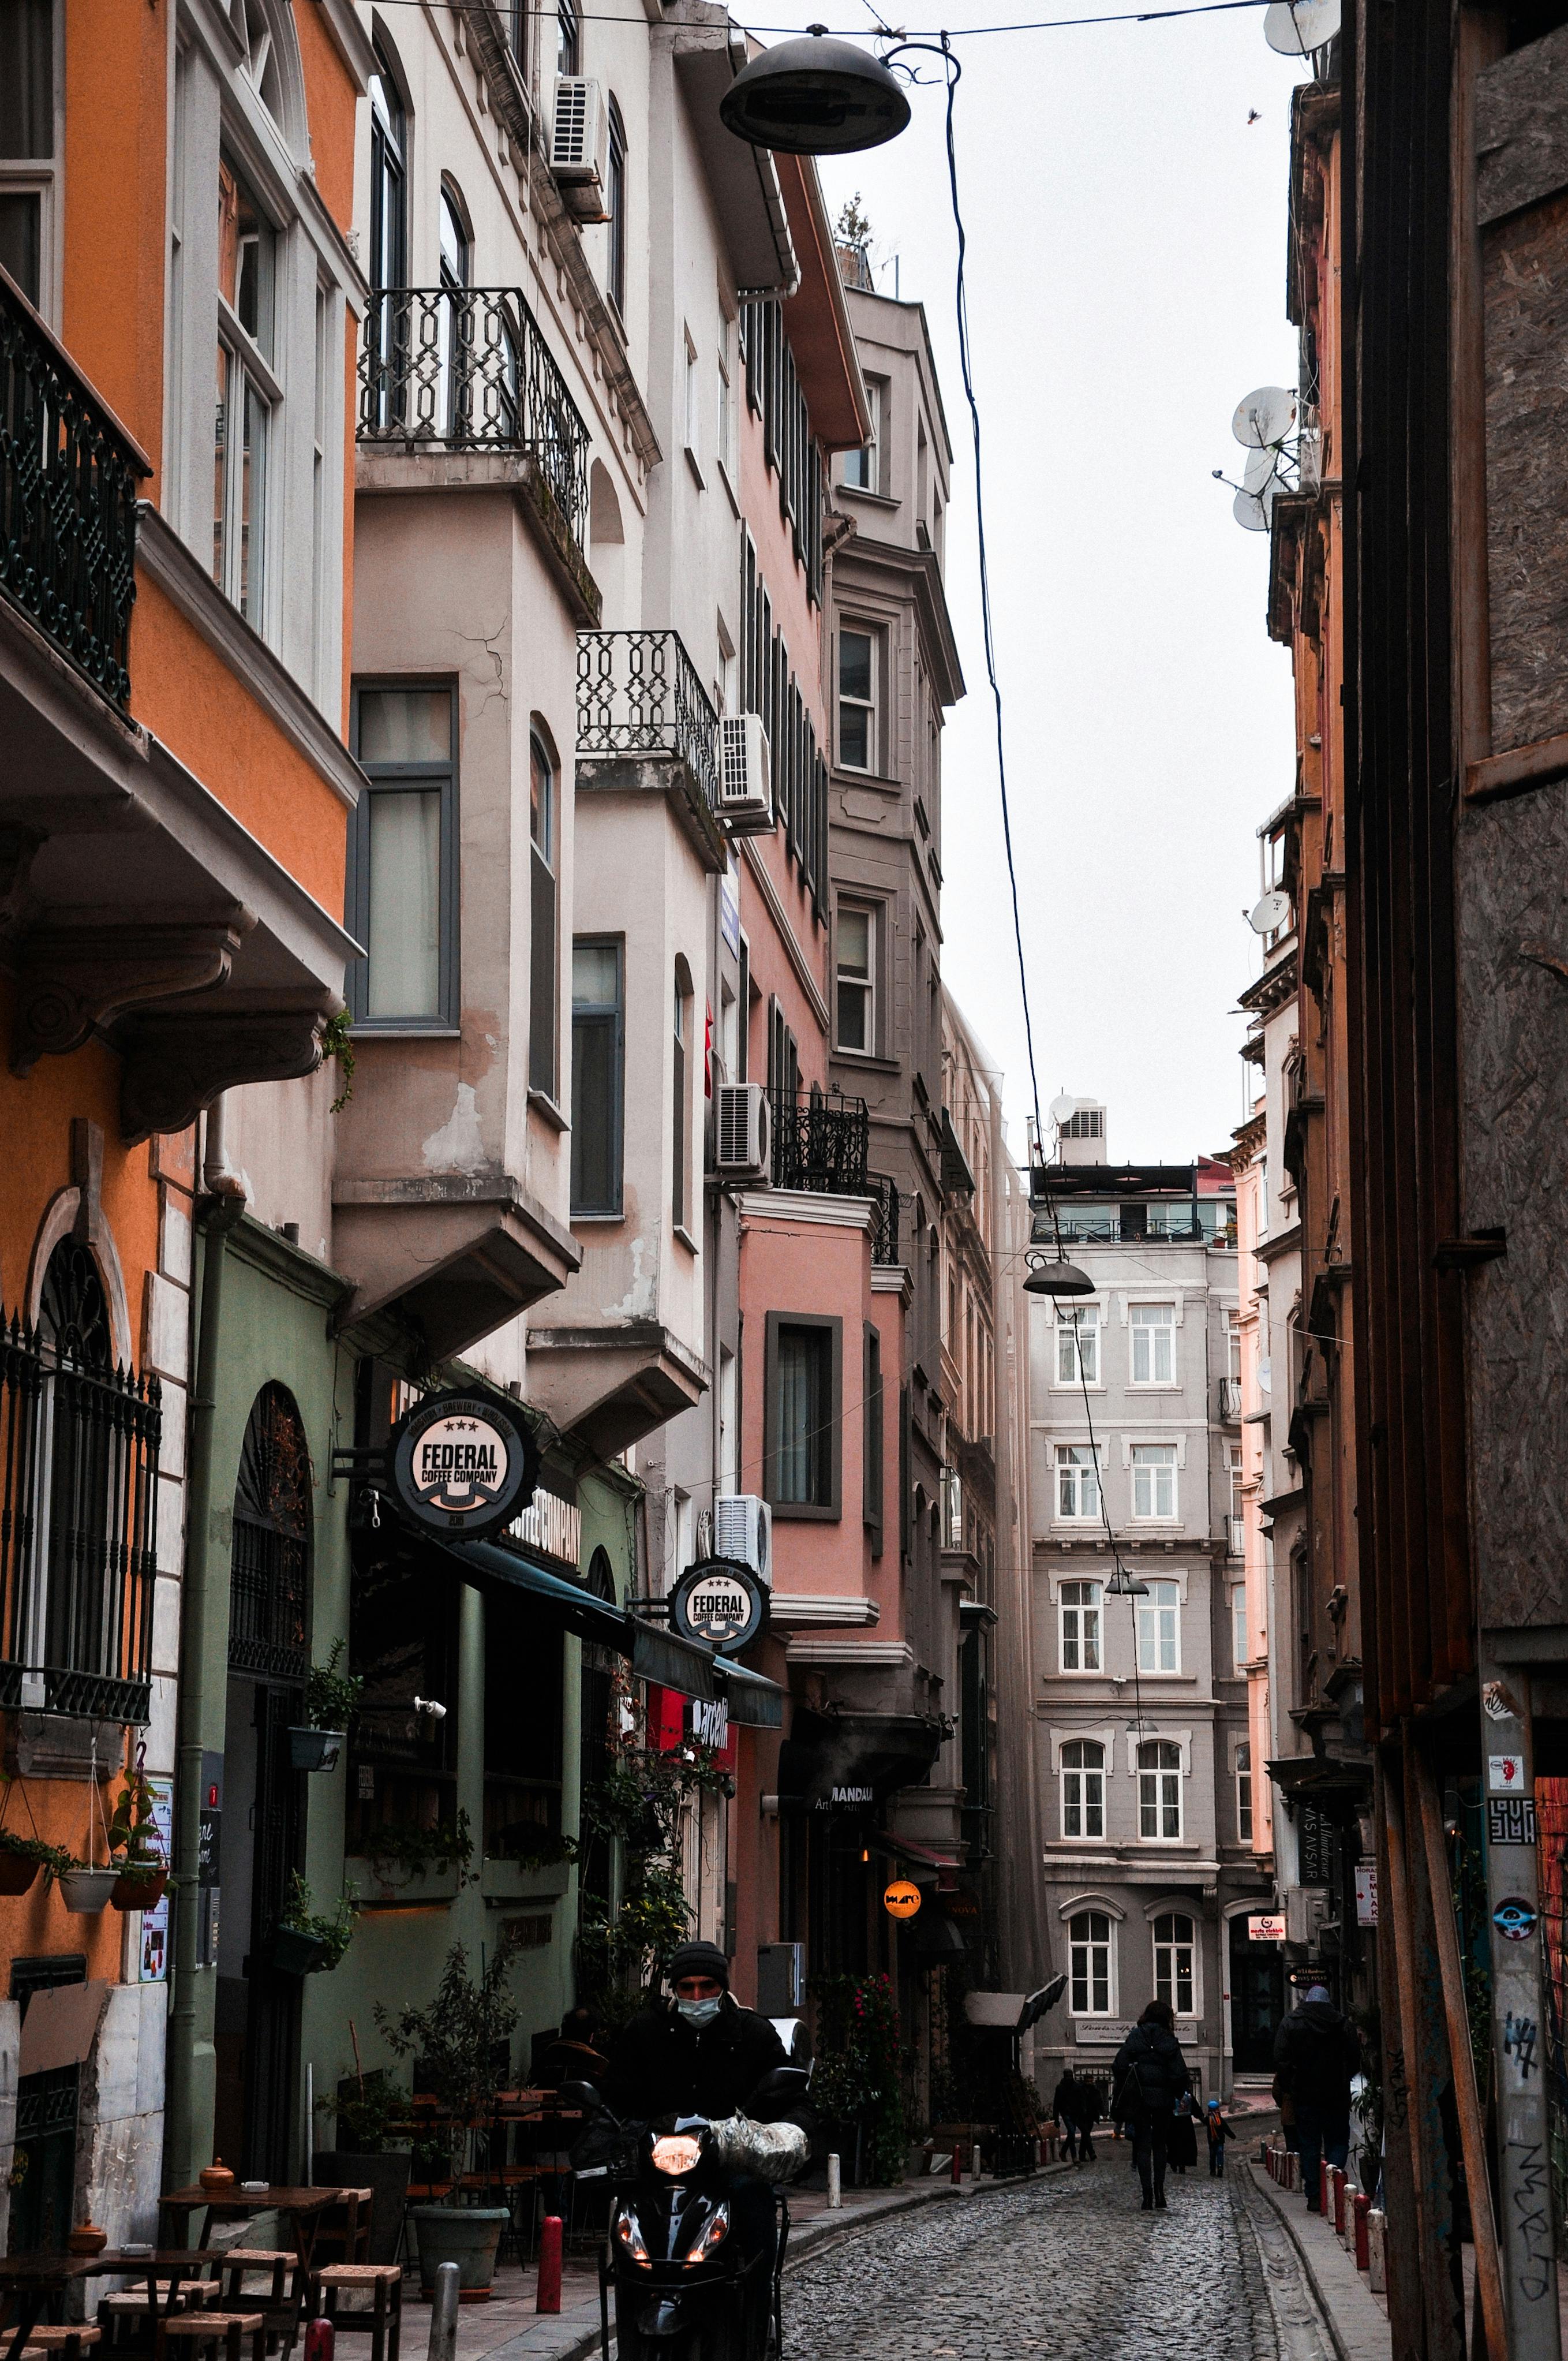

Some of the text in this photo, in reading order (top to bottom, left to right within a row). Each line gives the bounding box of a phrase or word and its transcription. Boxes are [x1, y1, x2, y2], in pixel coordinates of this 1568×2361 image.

[443, 1401, 477, 1414] BREWERY
[422, 1444, 497, 1470] FEDERAL
[422, 1470, 497, 1483] COFFEE COMPANY
[541, 1489, 582, 1566] COMPANY
[694, 1596, 744, 1612] FEDERAL
[693, 1613, 744, 1622] COFFEE COMPANY
